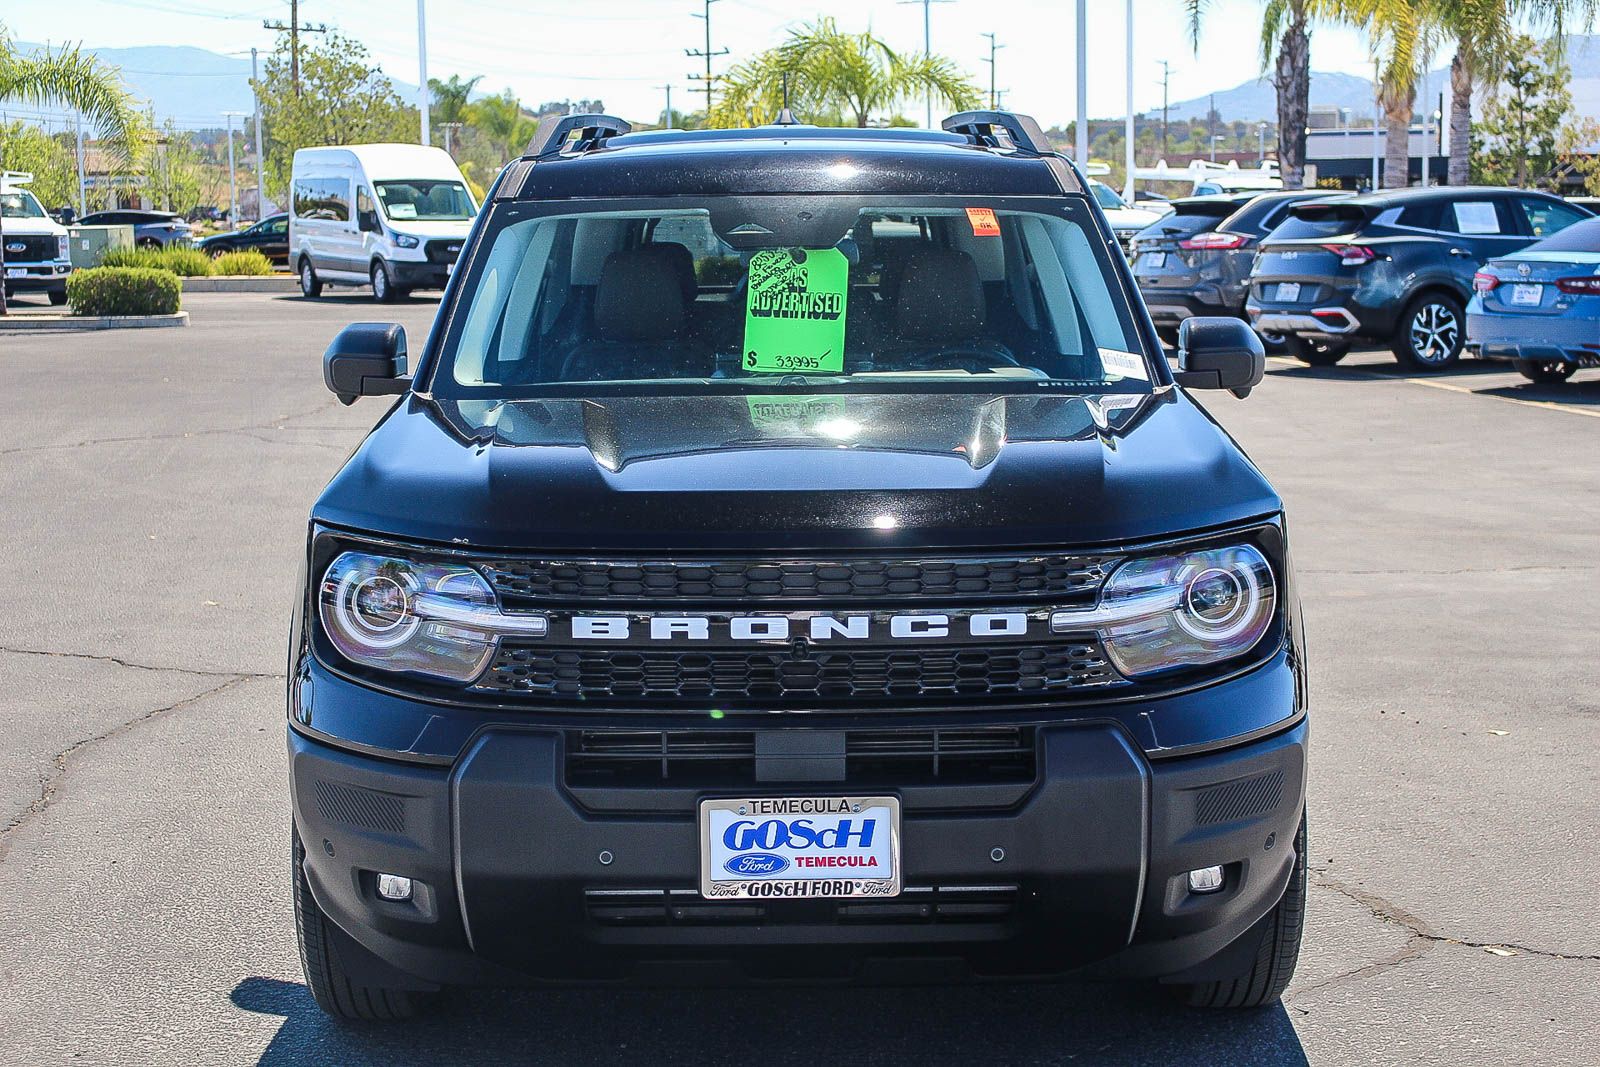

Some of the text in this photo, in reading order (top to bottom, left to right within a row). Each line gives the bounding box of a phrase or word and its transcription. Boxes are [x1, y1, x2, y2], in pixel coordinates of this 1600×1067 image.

[789, 267, 808, 291] AS
[750, 290, 843, 320] ADVERTISED
[571, 613, 1028, 640] BRONCO
[749, 799, 851, 814] TEMECULA
[738, 855, 878, 873] Ford TEMECULA
[709, 884, 740, 897] Ford
[811, 881, 854, 896] FORD
[862, 881, 893, 895] Ford
